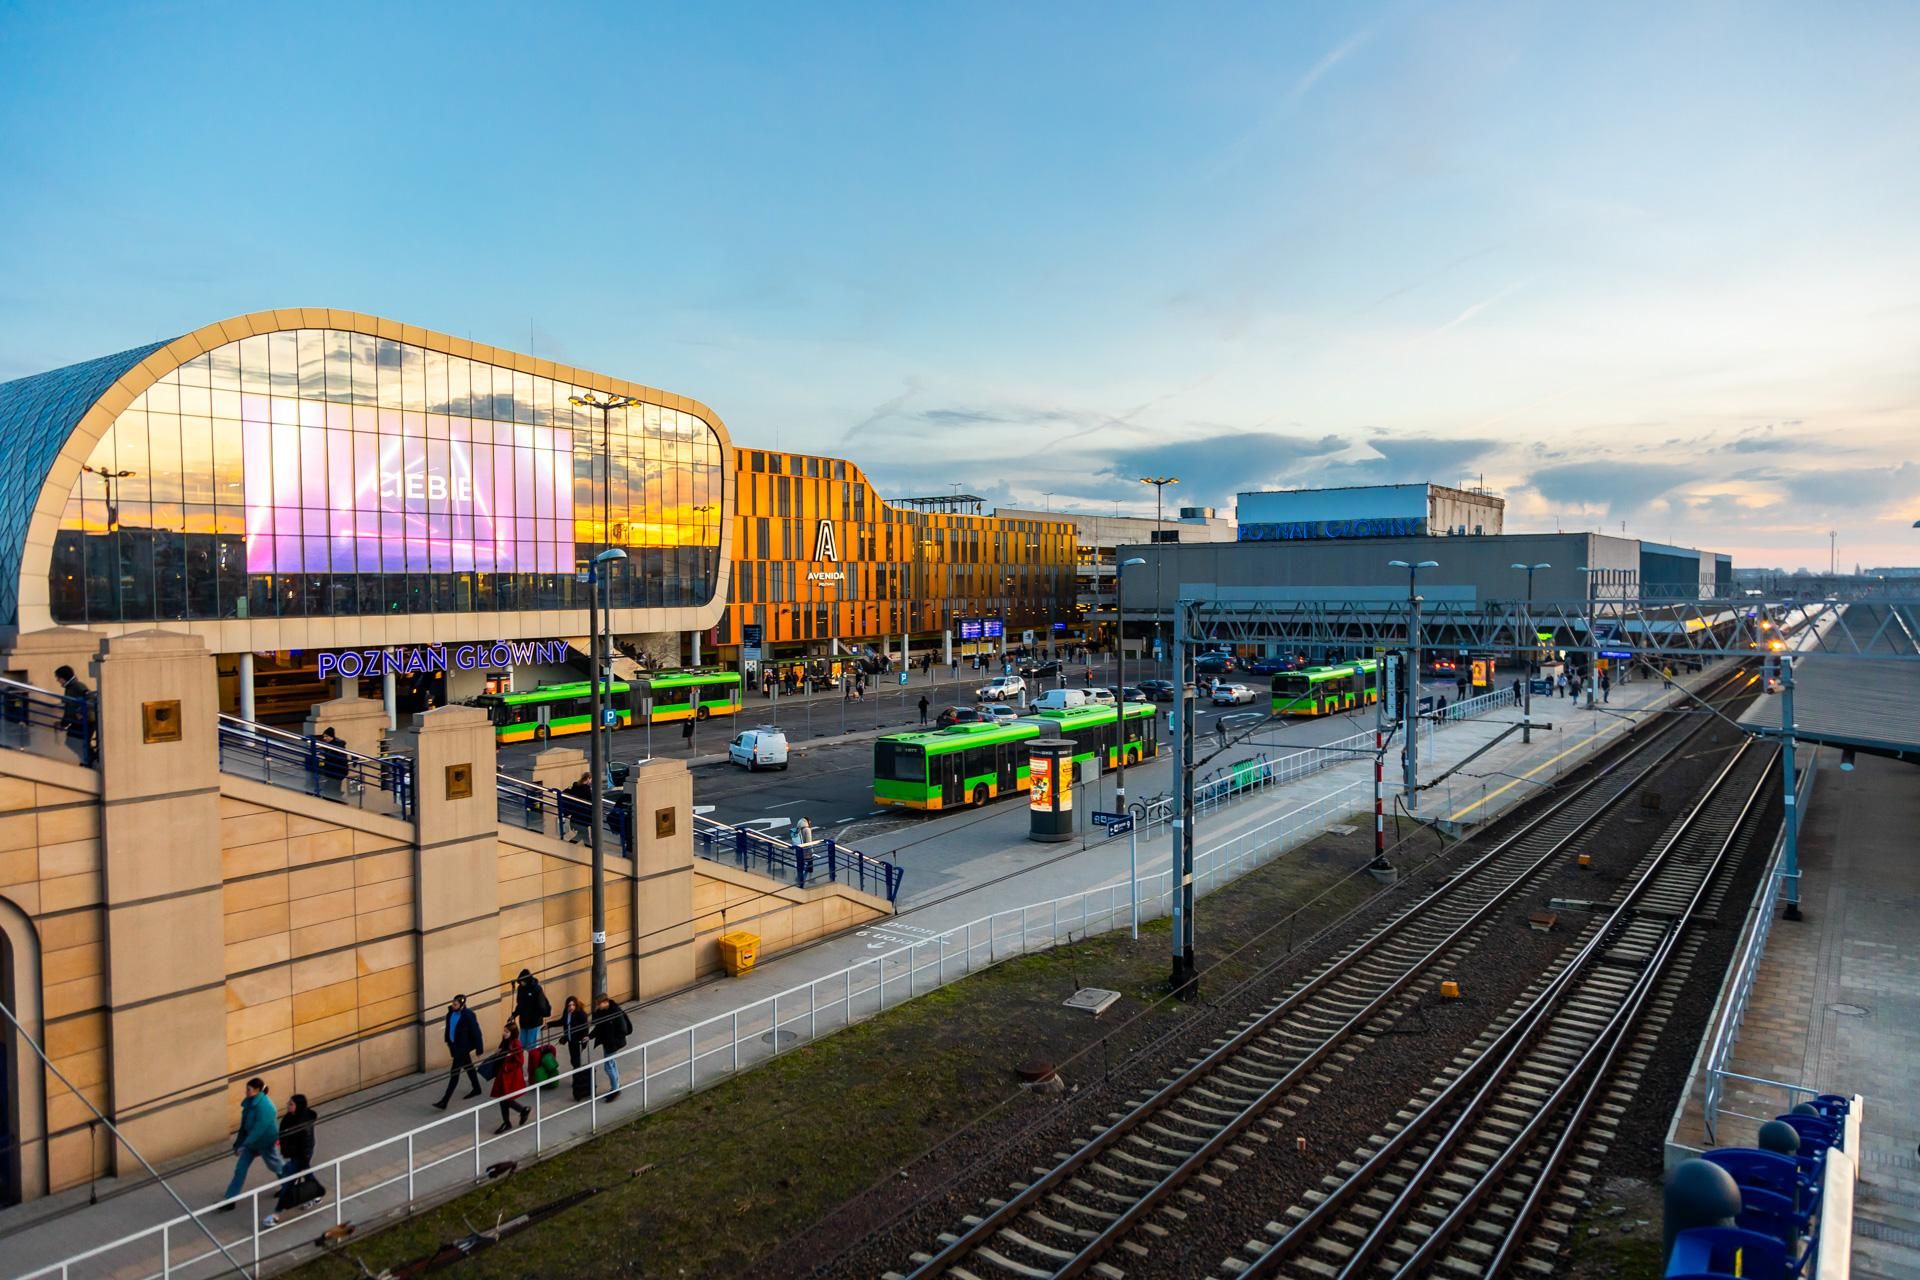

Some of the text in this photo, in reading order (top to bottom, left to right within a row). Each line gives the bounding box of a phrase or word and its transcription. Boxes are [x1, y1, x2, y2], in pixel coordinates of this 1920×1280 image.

[372, 471, 473, 501] CIEBIE
[815, 520, 838, 561] A
[1238, 521, 1318, 540] PONA
[808, 572, 845, 580] AVENIDA
[318, 640, 569, 679] POZNAŃ GŁÓWNY
[607, 711, 614, 722] P
